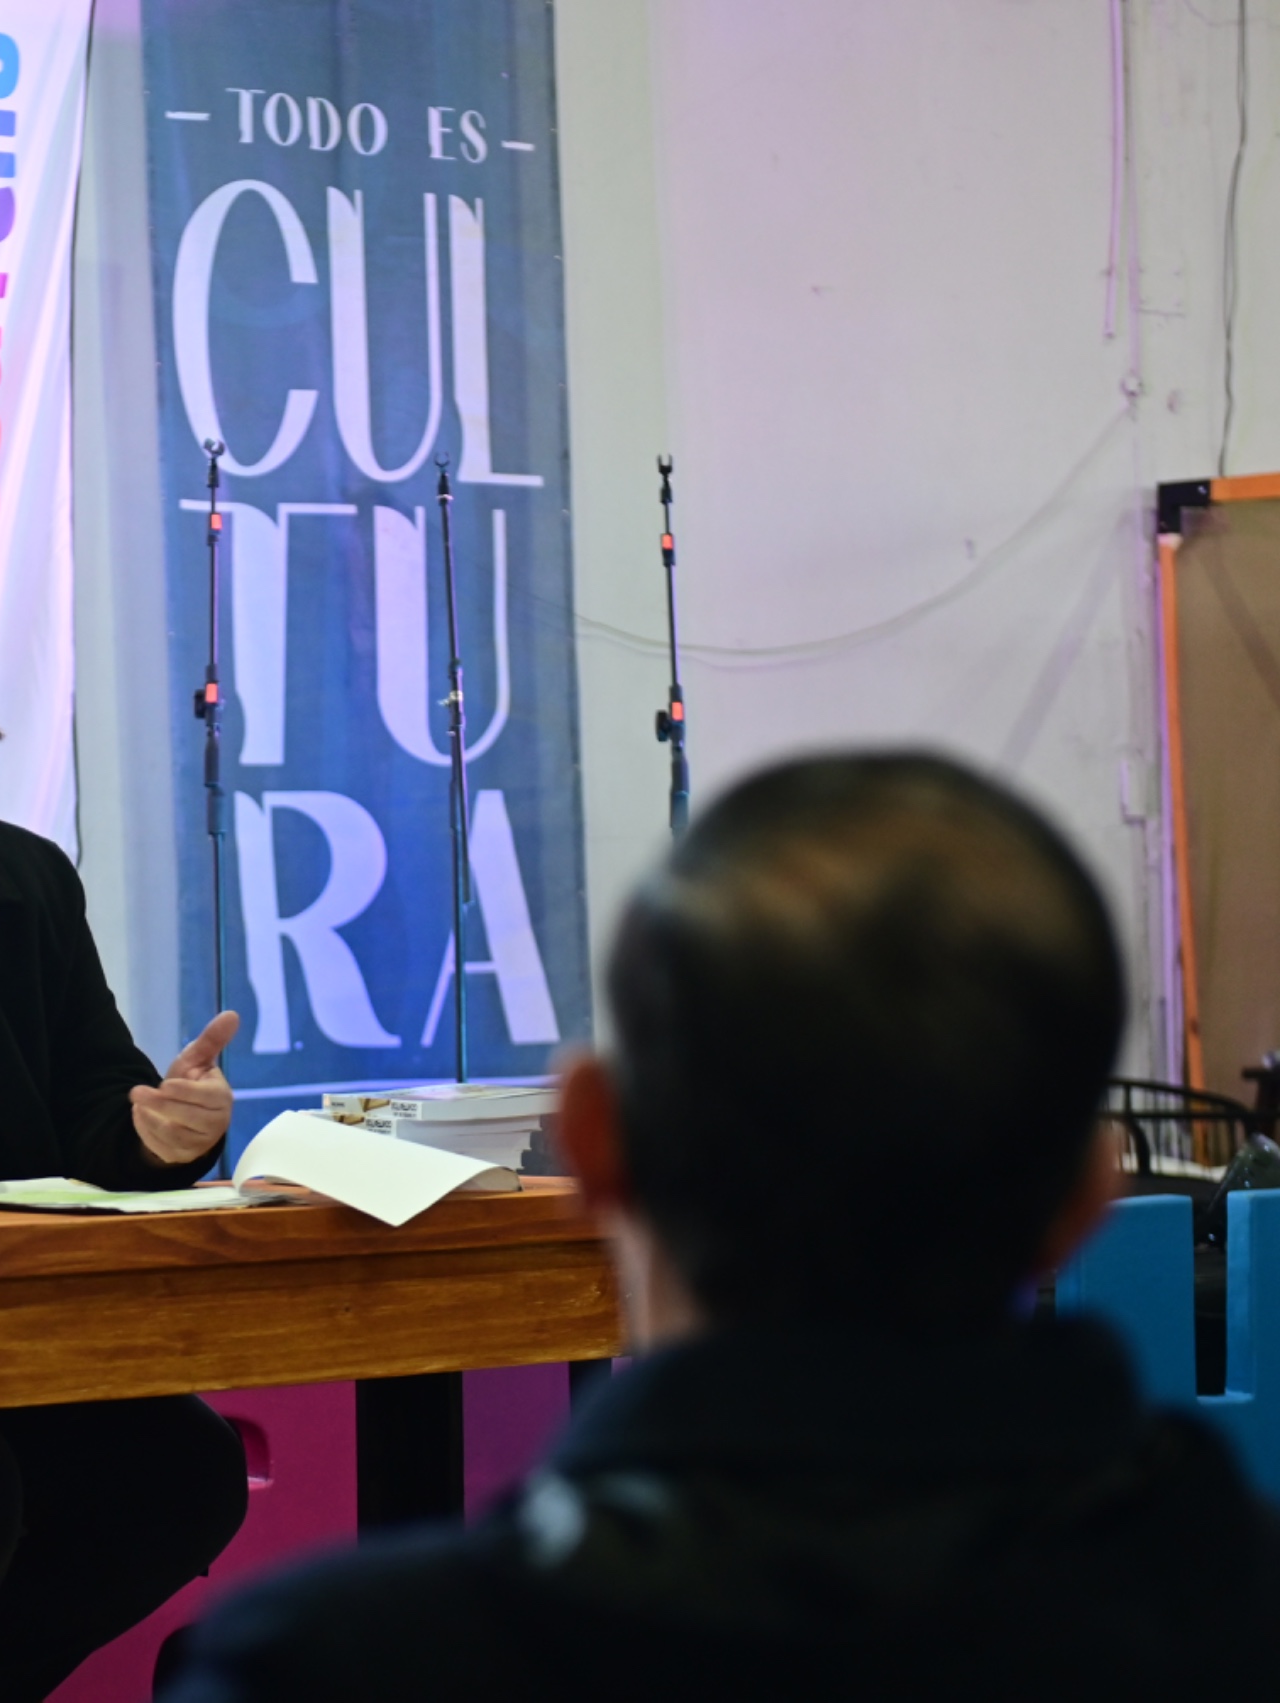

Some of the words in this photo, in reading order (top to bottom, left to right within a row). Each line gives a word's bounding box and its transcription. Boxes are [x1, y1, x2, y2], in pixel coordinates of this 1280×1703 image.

[225, 87, 389, 156] TODO
[427, 106, 489, 163] ES
[172, 179, 544, 486] CUL
[180, 498, 511, 766] TU
[234, 788, 560, 1054] RA
